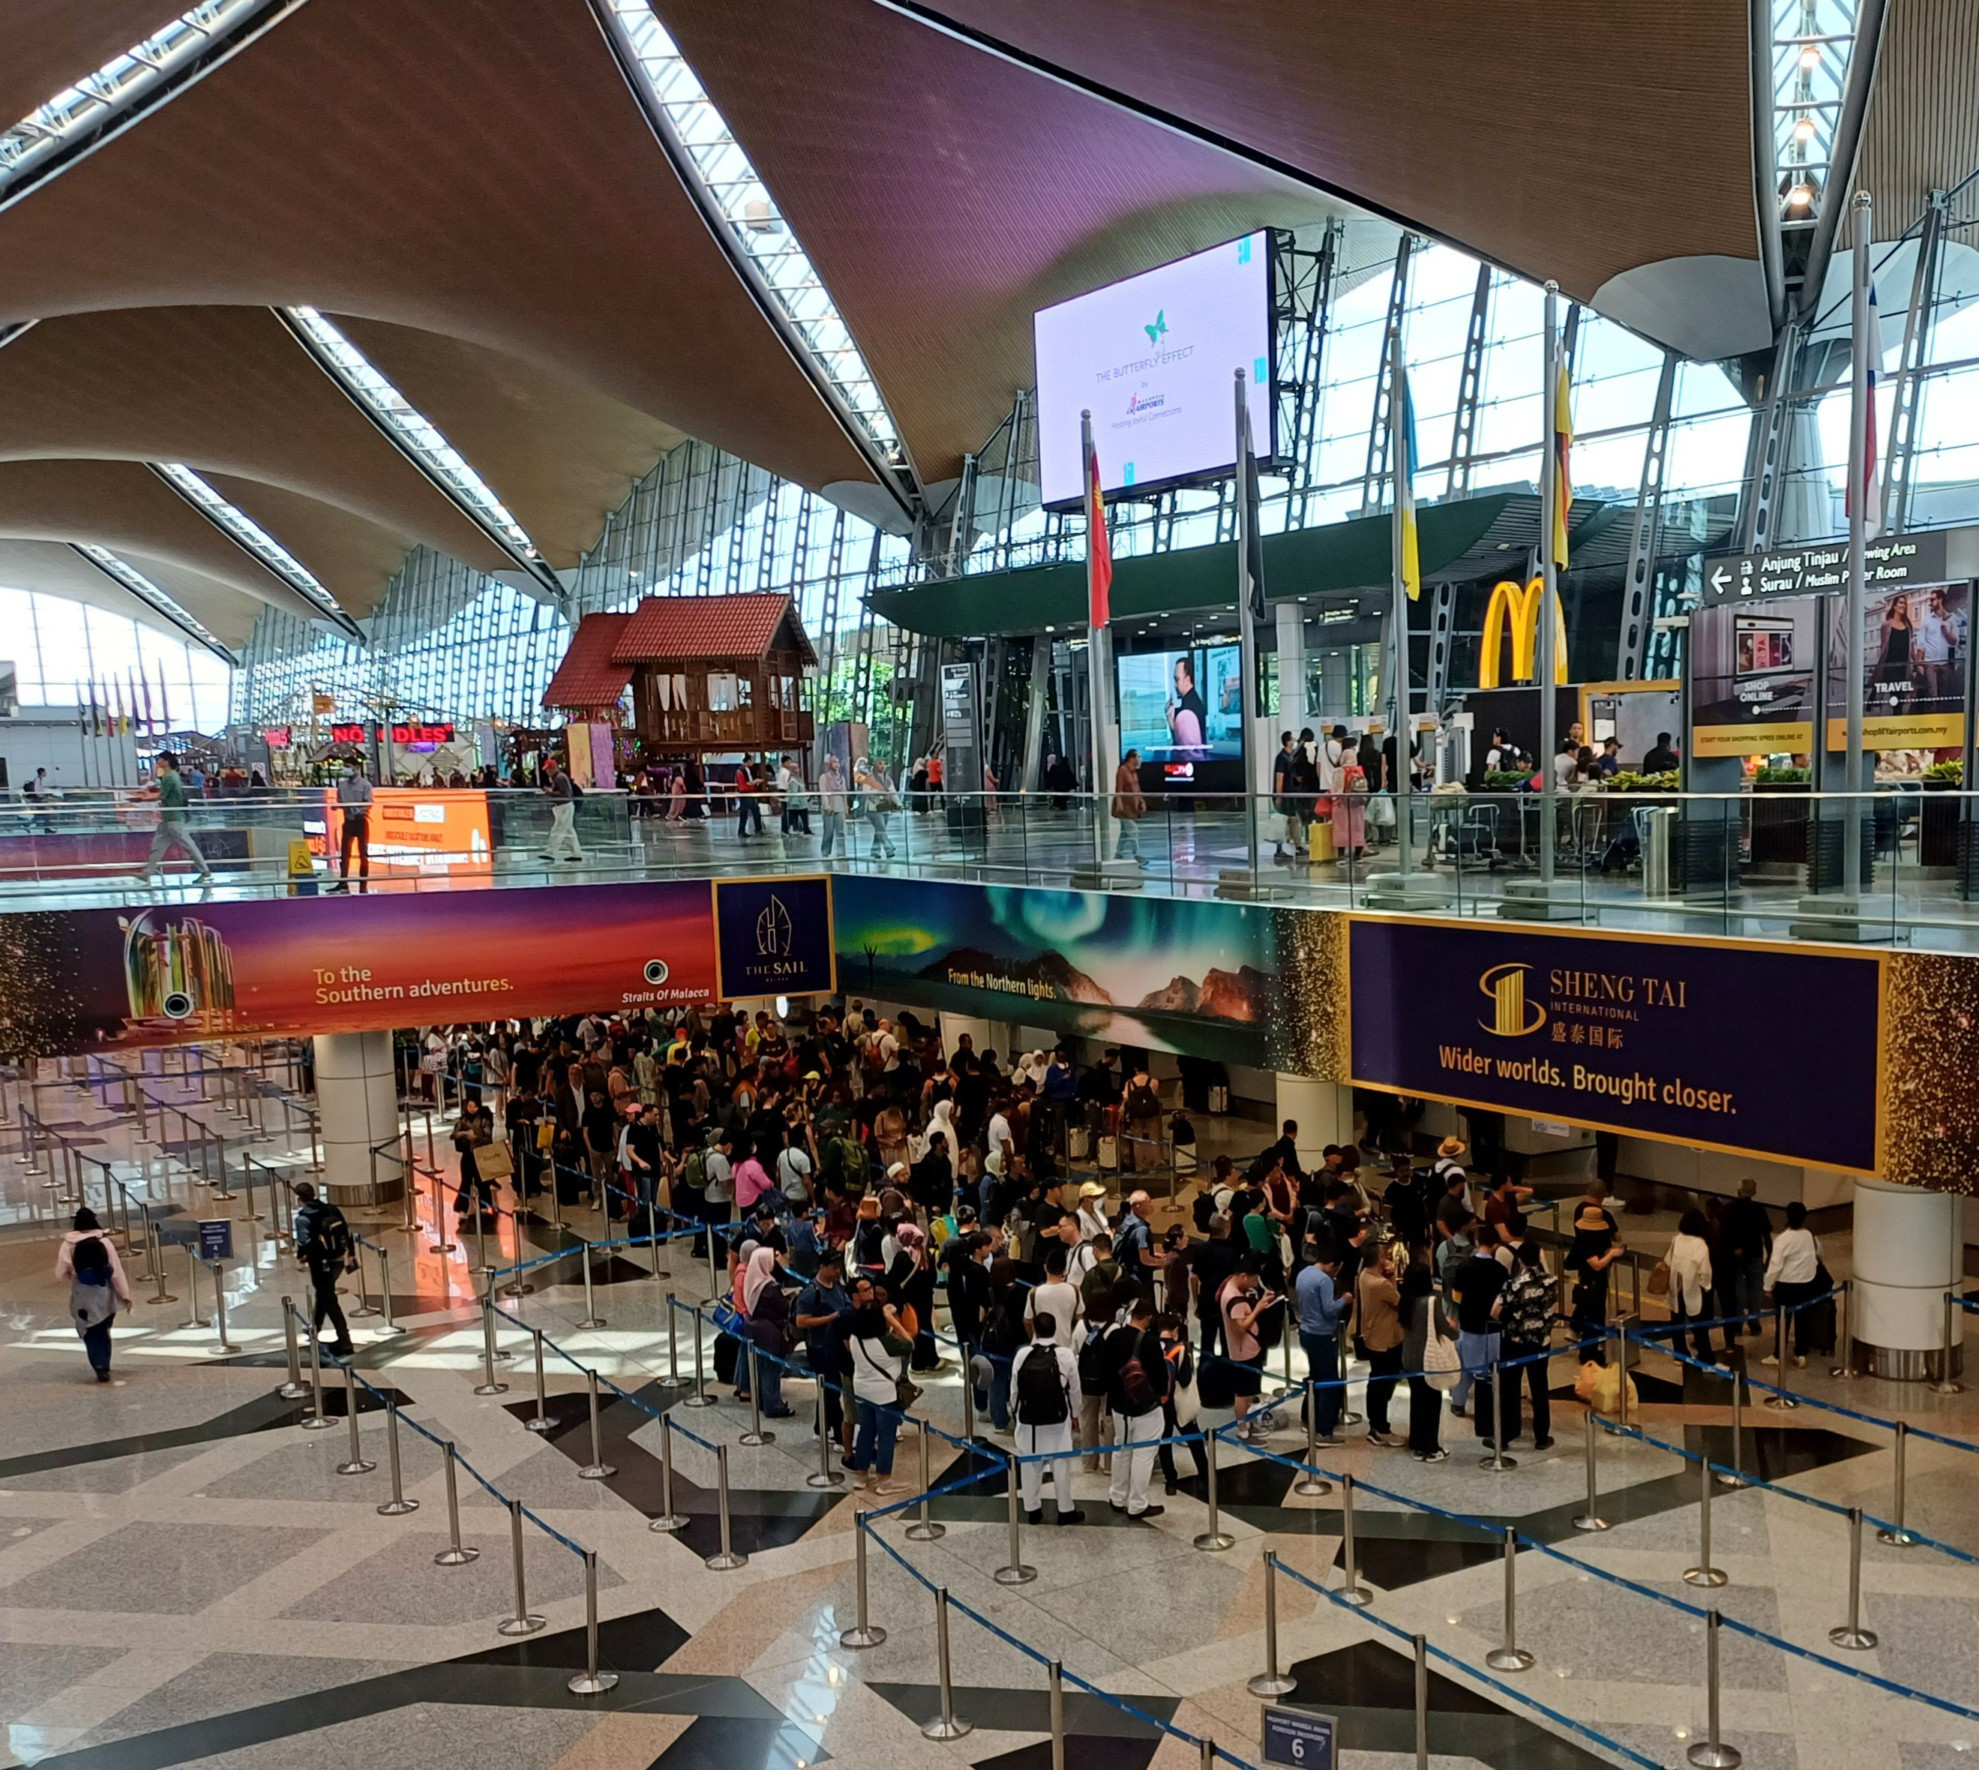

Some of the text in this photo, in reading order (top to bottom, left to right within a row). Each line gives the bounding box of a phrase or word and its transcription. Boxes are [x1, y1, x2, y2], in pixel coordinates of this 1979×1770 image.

[1096, 345, 1194, 382] THE BUTTERFLY EFFECT
[1760, 556, 1801, 574] Anjung
[1802, 551, 1839, 569] Tinjau
[1890, 542, 1916, 557] Area
[1760, 576, 1793, 593] Surau
[1795, 571, 1804, 589] /
[1804, 573, 1840, 588] Muslim
[1876, 565, 1908, 580] Room
[1740, 691, 1773, 702] ONLINE
[1744, 681, 1769, 692] SHOP
[1875, 681, 1914, 693] TRAVEL
[313, 966, 372, 985] To the
[745, 961, 808, 976] THE SAIL
[315, 978, 514, 1004] Southern adventures.
[622, 987, 710, 1004] Straits Of Malacca
[948, 968, 1057, 1000] From the Northern lights.
[1550, 969, 1687, 1008] SHENG TAI
[1550, 1001, 1639, 1022] INTERNATIONAL
[1551, 1021, 1624, 1050] 盛泰国际
[1438, 1044, 1737, 1115] Wider worlds. Brought closer.
[1292, 1738, 1304, 1758] 6
